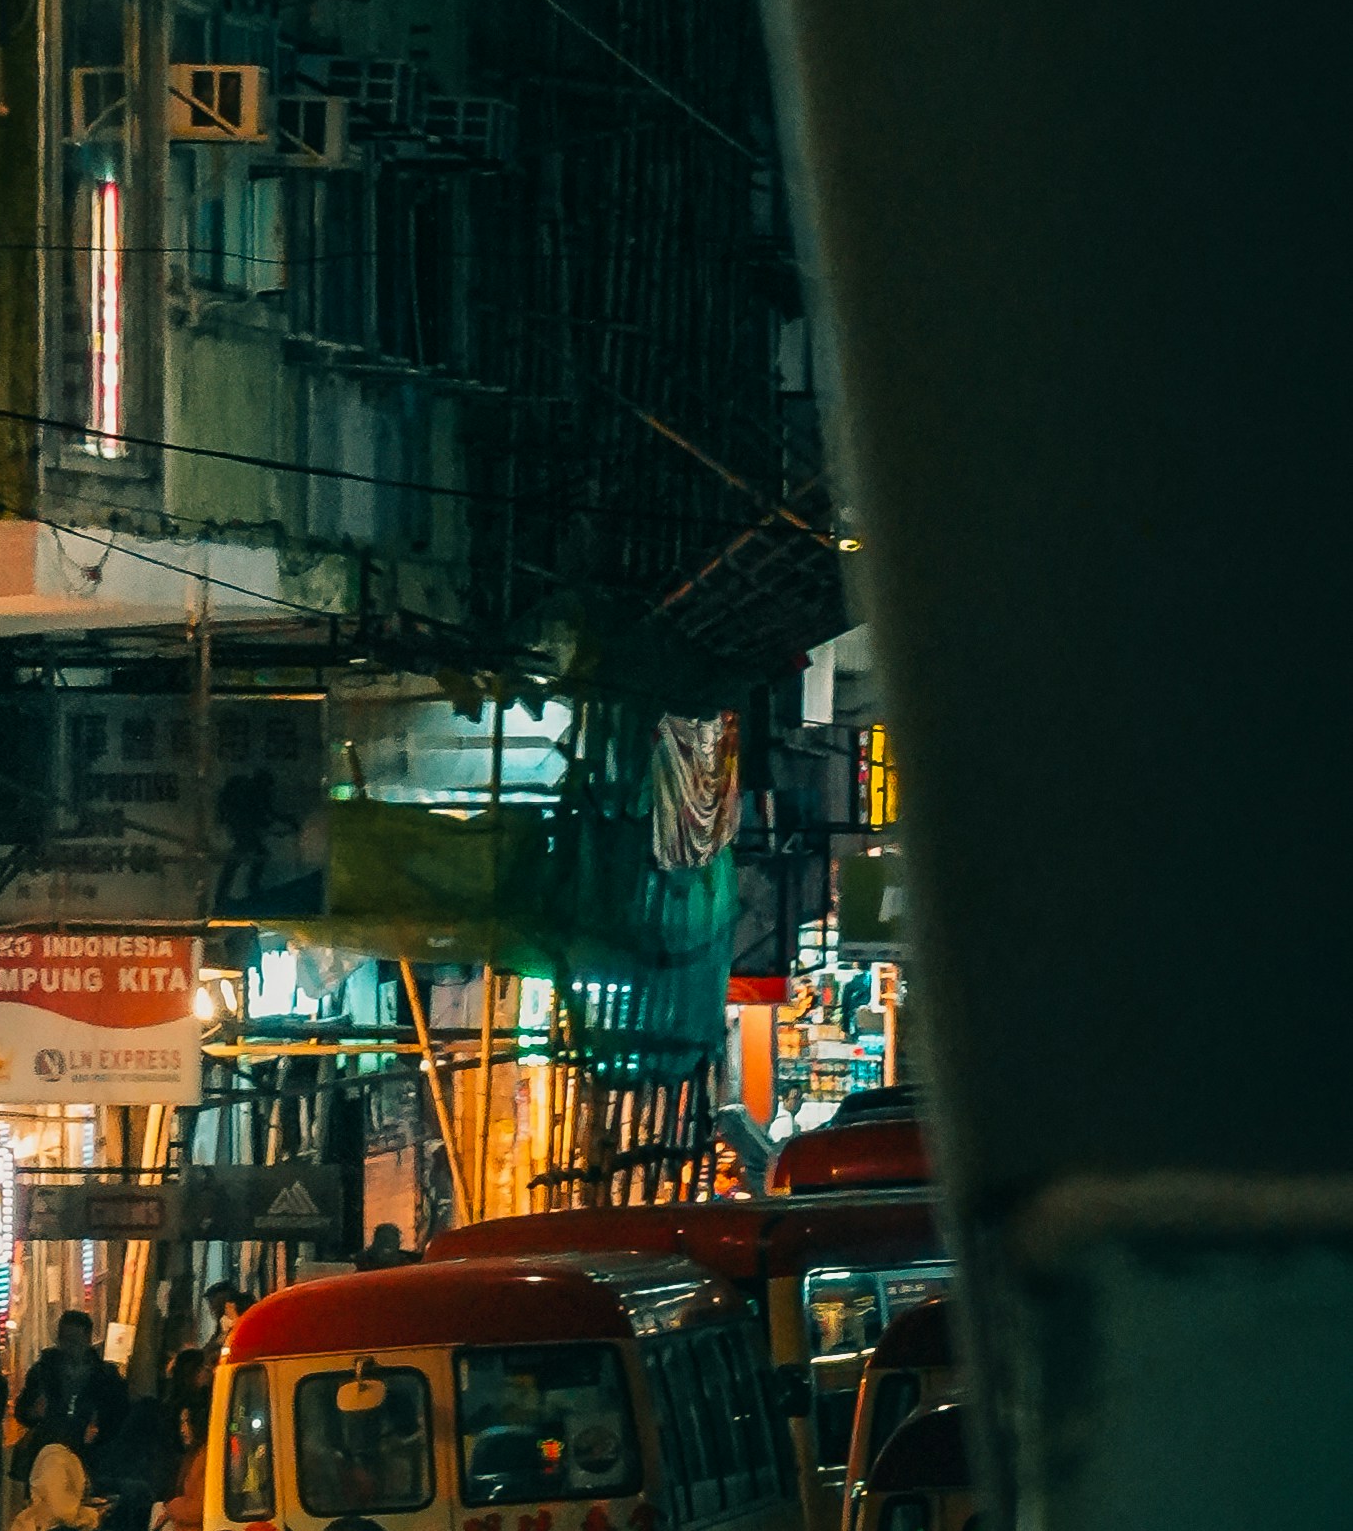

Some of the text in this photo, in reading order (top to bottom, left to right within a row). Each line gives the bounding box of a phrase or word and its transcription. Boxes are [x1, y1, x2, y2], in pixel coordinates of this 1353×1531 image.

[42, 936, 174, 958] INDONESIA
[118, 966, 189, 993] KITA
[99, 1048, 182, 1071] EXPRESS
